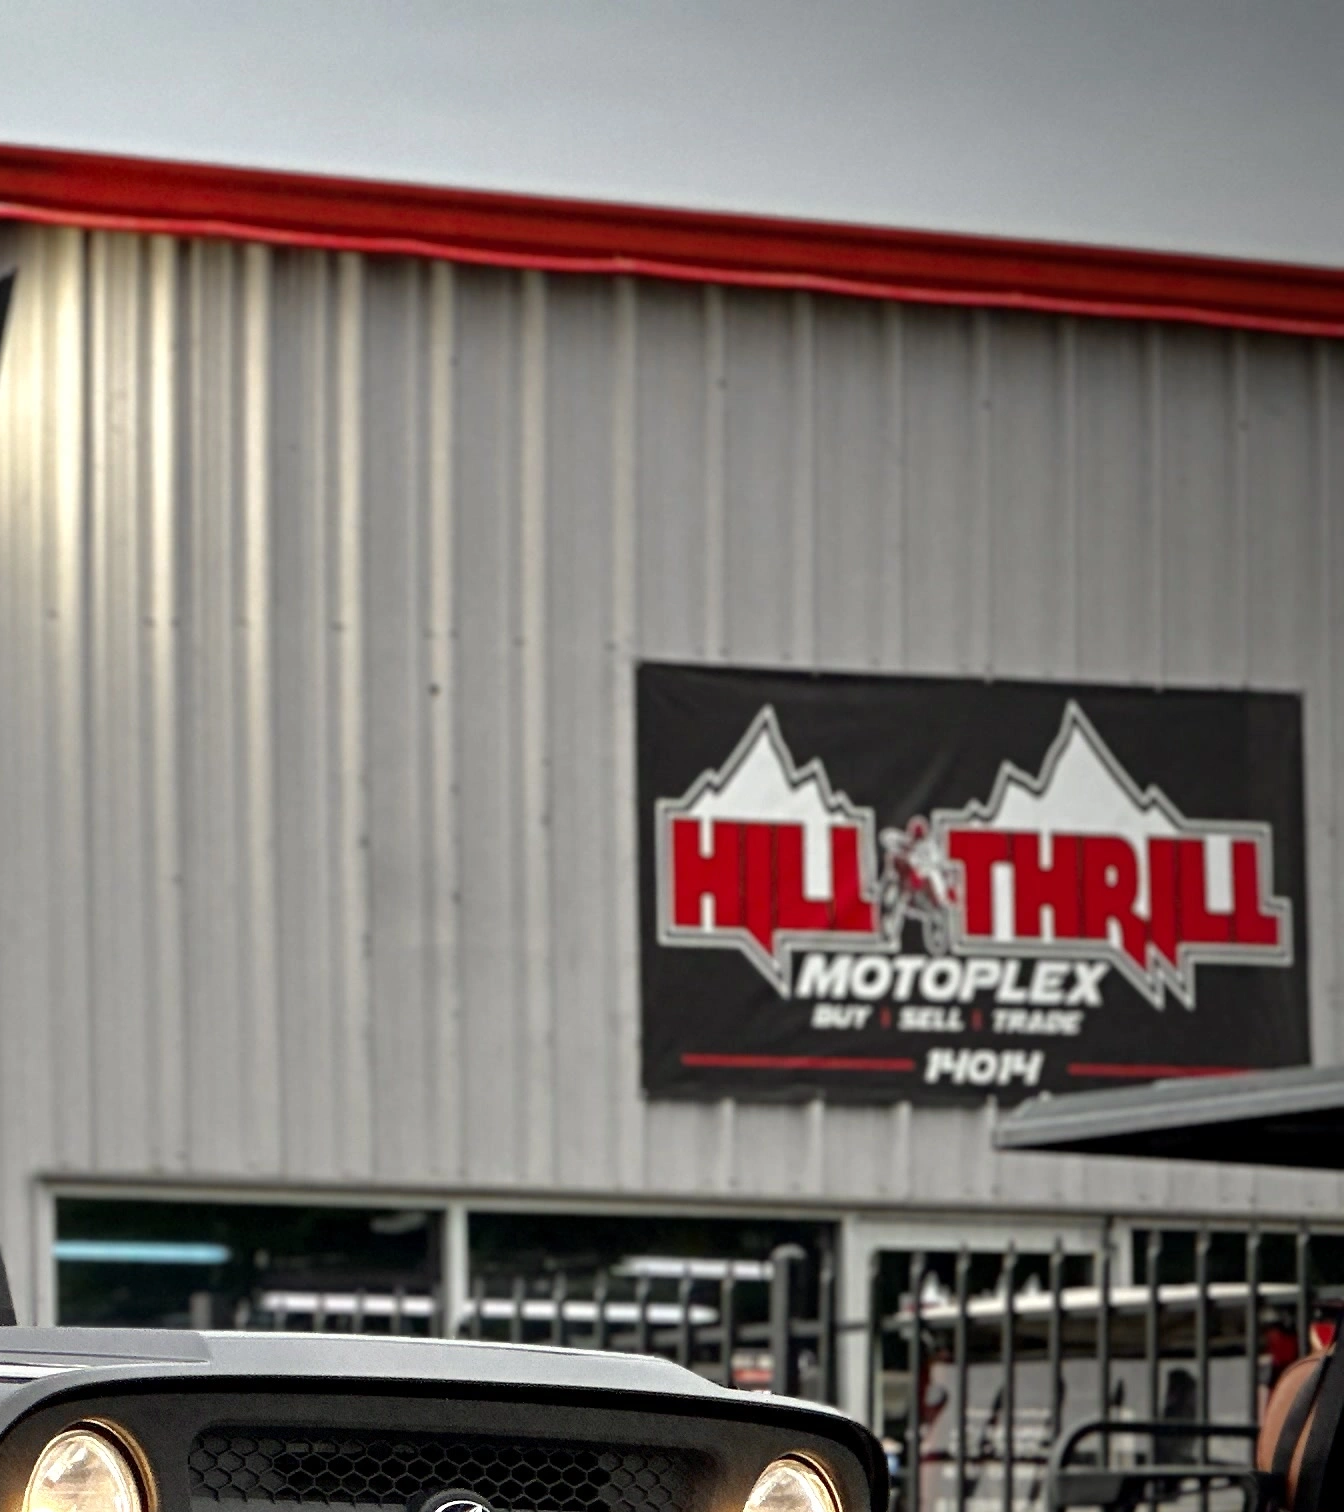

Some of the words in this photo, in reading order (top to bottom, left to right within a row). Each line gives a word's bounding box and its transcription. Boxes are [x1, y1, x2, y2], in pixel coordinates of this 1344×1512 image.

[671, 817, 876, 957] HILL
[946, 828, 1279, 973] THRILL
[796, 954, 1111, 1008] MOTOPLEX
[810, 1004, 874, 1030] BUY
[898, 1005, 966, 1034] SELL
[991, 1010, 1086, 1036] TRADE
[924, 1048, 1046, 1085] 14014
